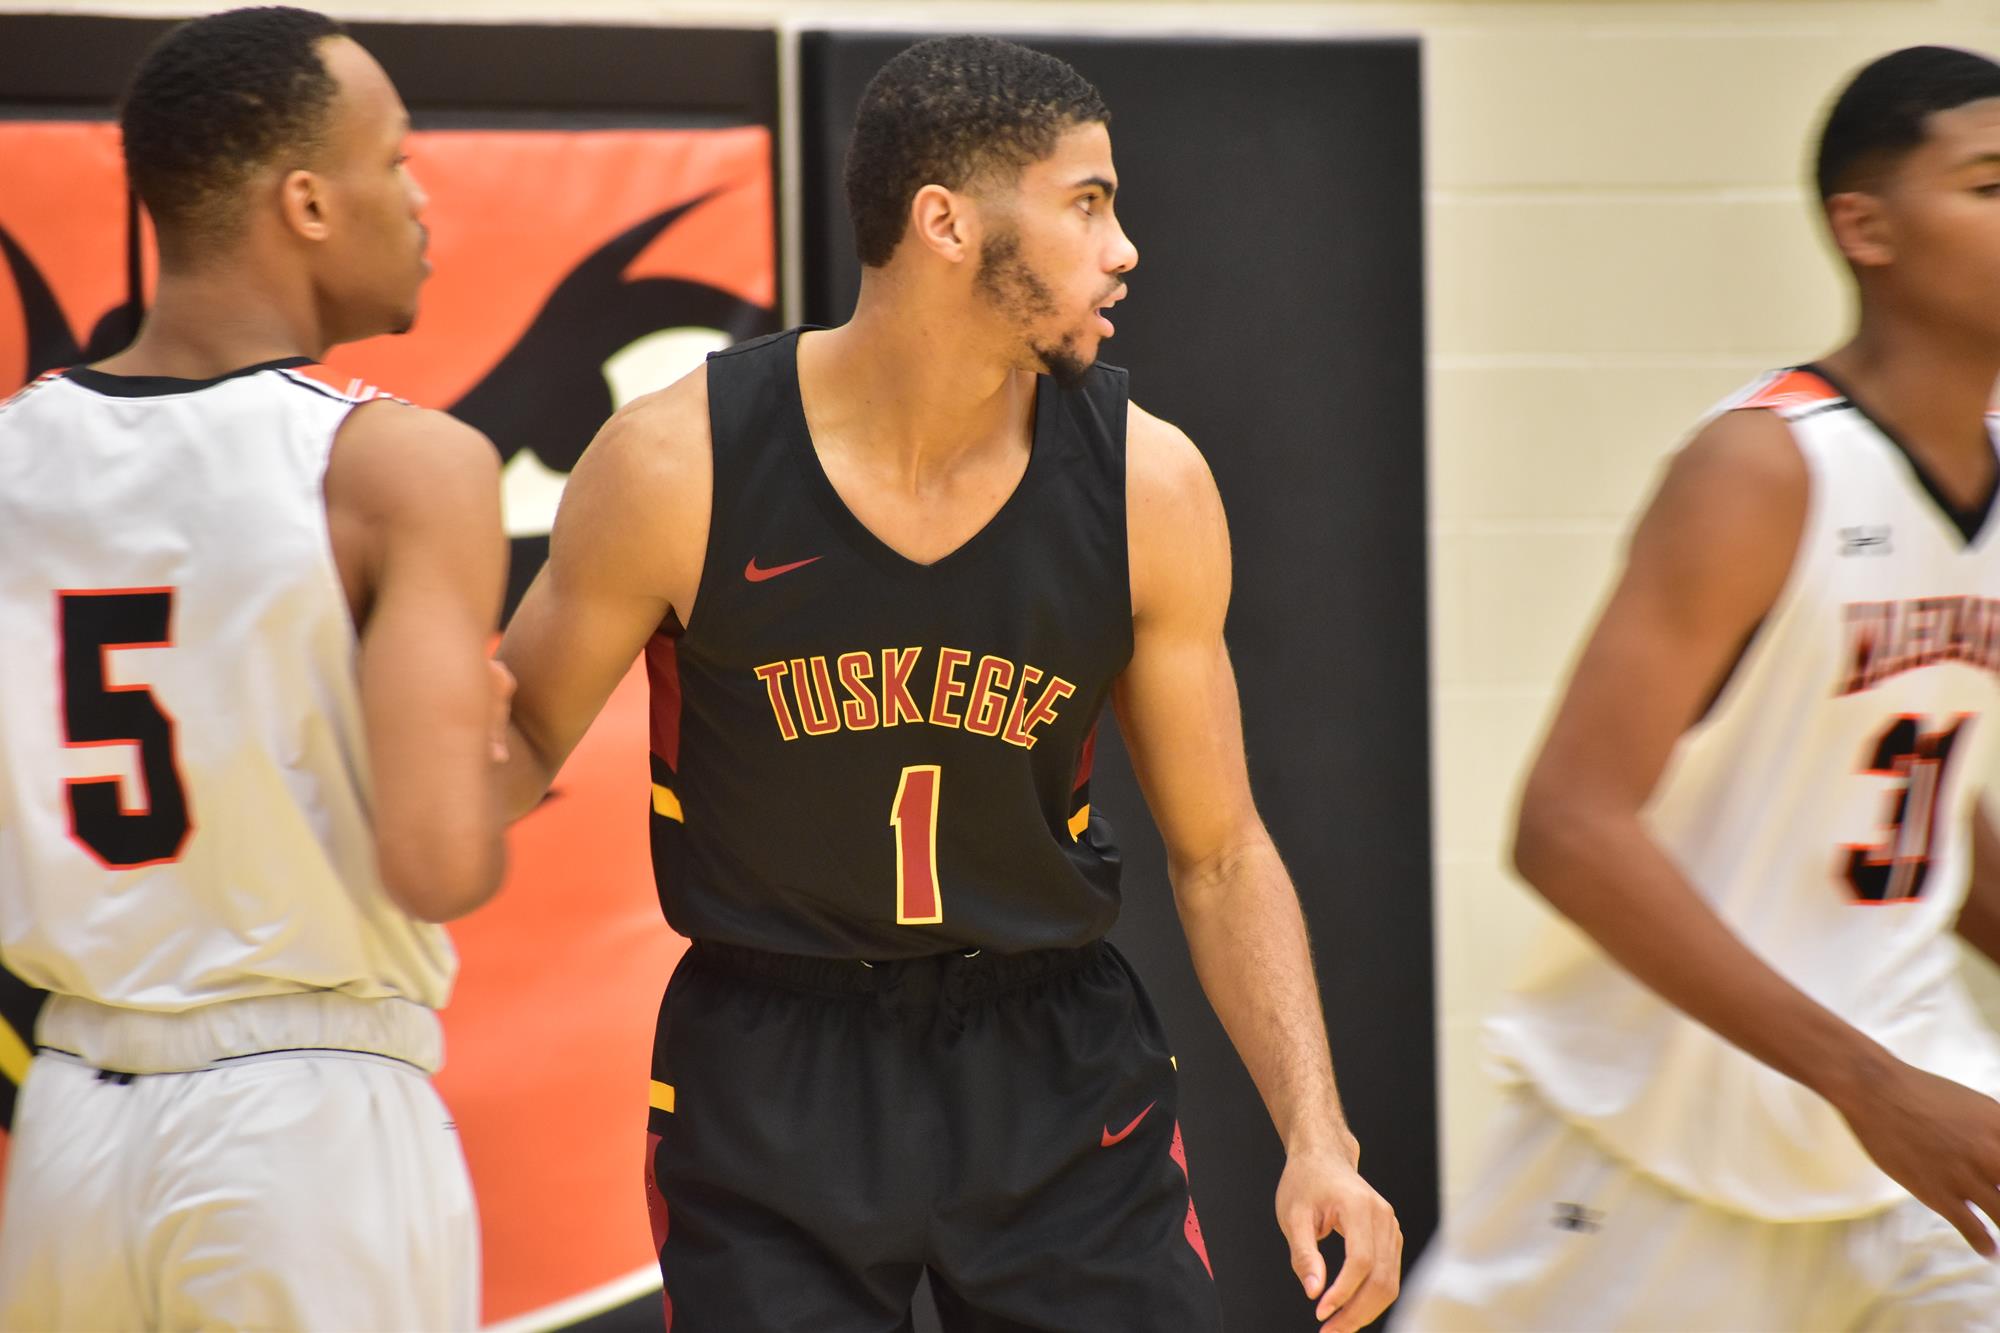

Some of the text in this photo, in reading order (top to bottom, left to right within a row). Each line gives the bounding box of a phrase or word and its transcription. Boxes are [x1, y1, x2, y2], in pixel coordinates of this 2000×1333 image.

[54, 586, 197, 870] 5
[753, 646, 1077, 750] TUSKEGEE
[889, 764, 943, 925] 1
